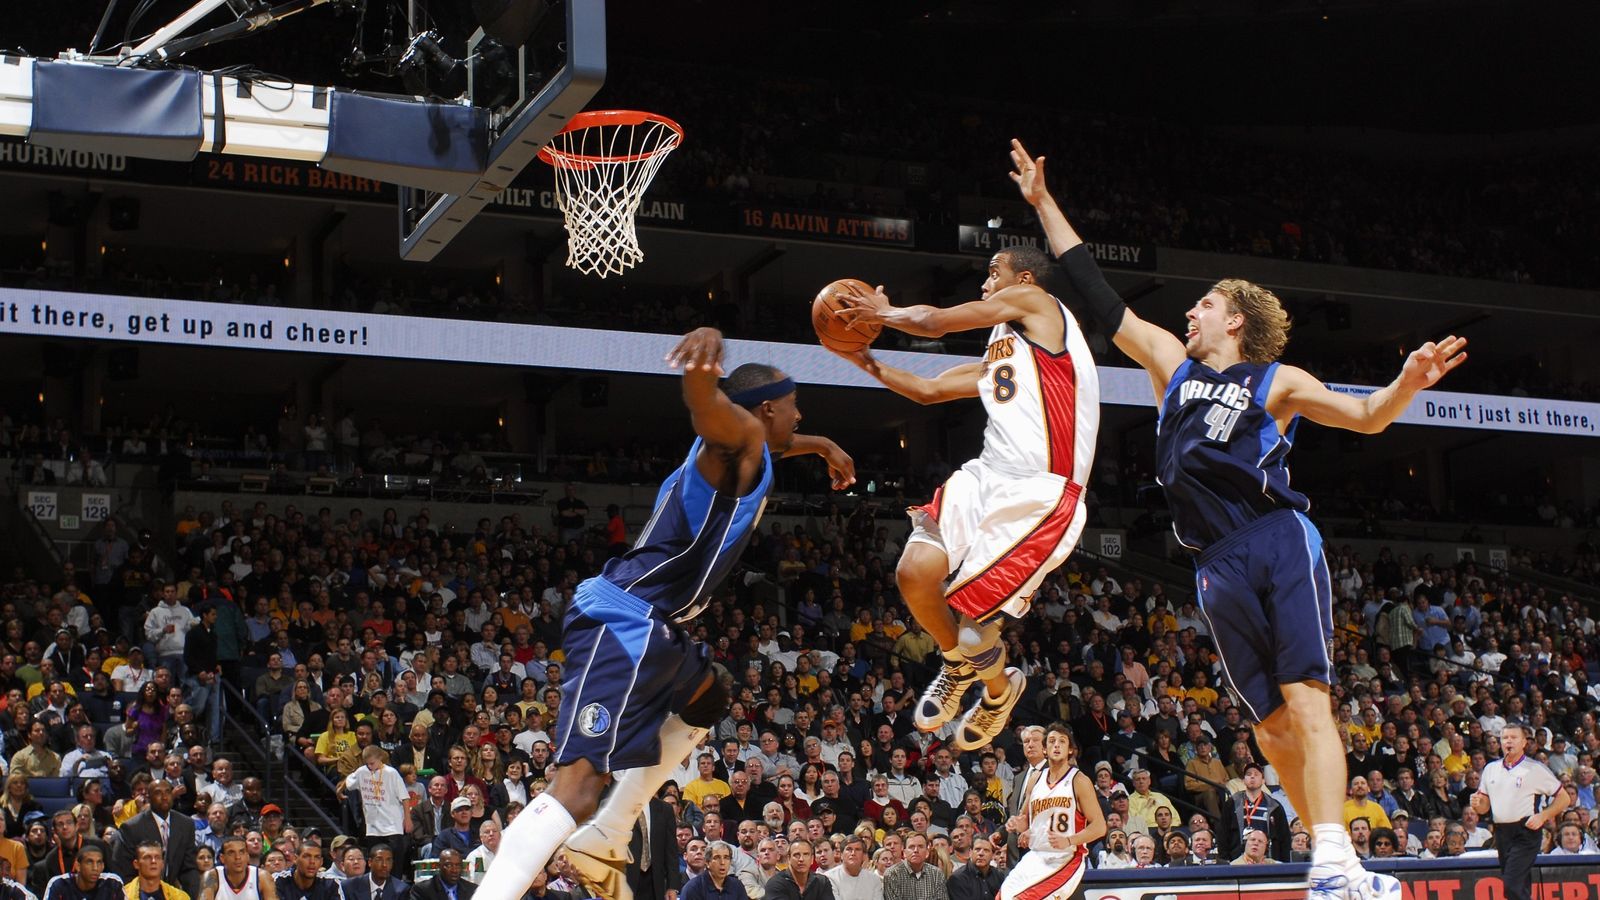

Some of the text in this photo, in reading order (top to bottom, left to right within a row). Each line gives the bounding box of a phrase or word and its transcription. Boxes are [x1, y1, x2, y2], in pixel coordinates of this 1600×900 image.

[208, 160, 383, 193] 24 RICK BARRY
[743, 209, 909, 241] 16 ALVIN ATTLES
[973, 231, 991, 249] 14
[998, 235, 1037, 250] TOM
[32, 304, 114, 333] there,
[128, 313, 170, 335] get
[183, 318, 213, 339] up
[227, 320, 273, 339] and
[286, 322, 368, 346] cheer!
[993, 363, 1018, 405] 8
[1179, 379, 1252, 411] DALLAS
[1203, 403, 1242, 442] 41
[1426, 401, 1595, 432] Don't just sit there,
[34, 495, 51, 503] SEC
[87, 497, 104, 506] SEC
[31, 504, 55, 517] 127
[83, 506, 108, 520] 128
[1103, 544, 1120, 556] 102
[1030, 796, 1072, 818] WARRIORS
[1050, 812, 1069, 833] 18
